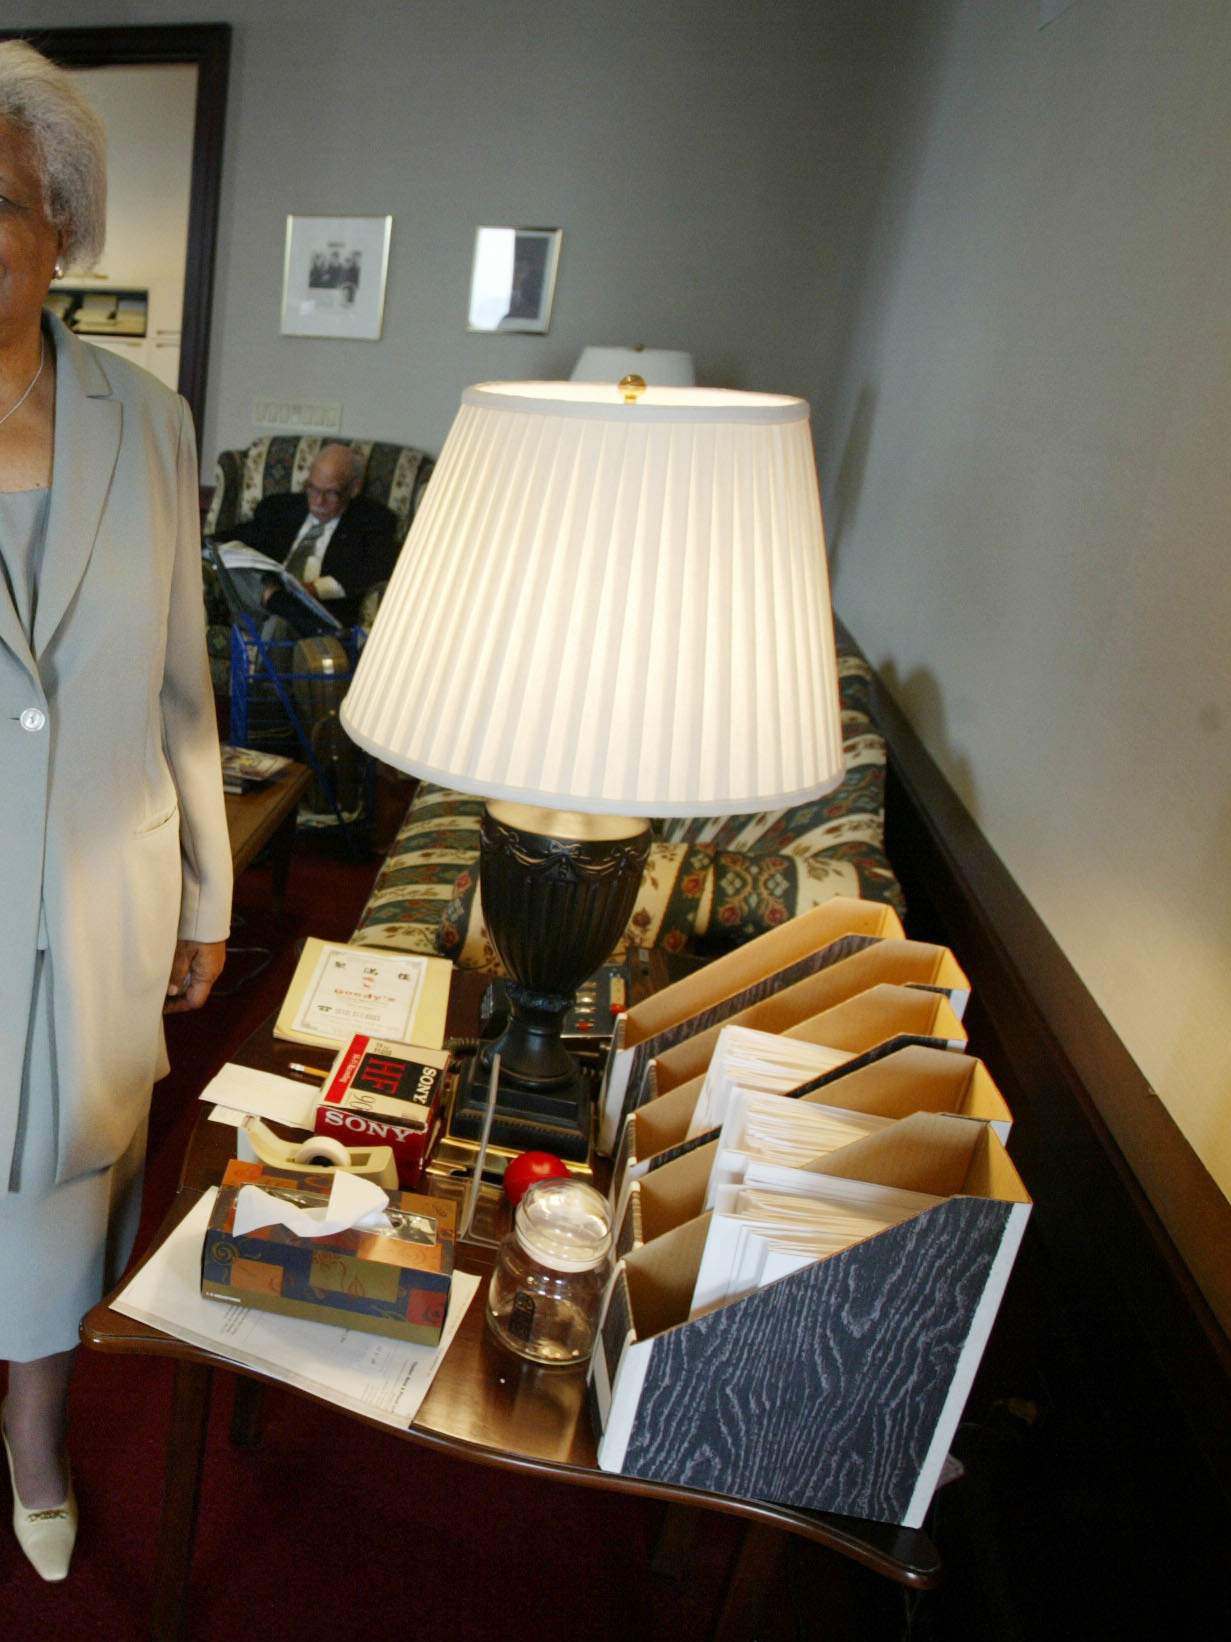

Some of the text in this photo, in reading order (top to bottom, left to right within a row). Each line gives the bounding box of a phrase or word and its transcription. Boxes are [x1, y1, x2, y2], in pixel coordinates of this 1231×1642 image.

[362, 1058, 406, 1094] HF
[413, 1067, 437, 1104] SONY
[324, 1111, 413, 1142] SONY
